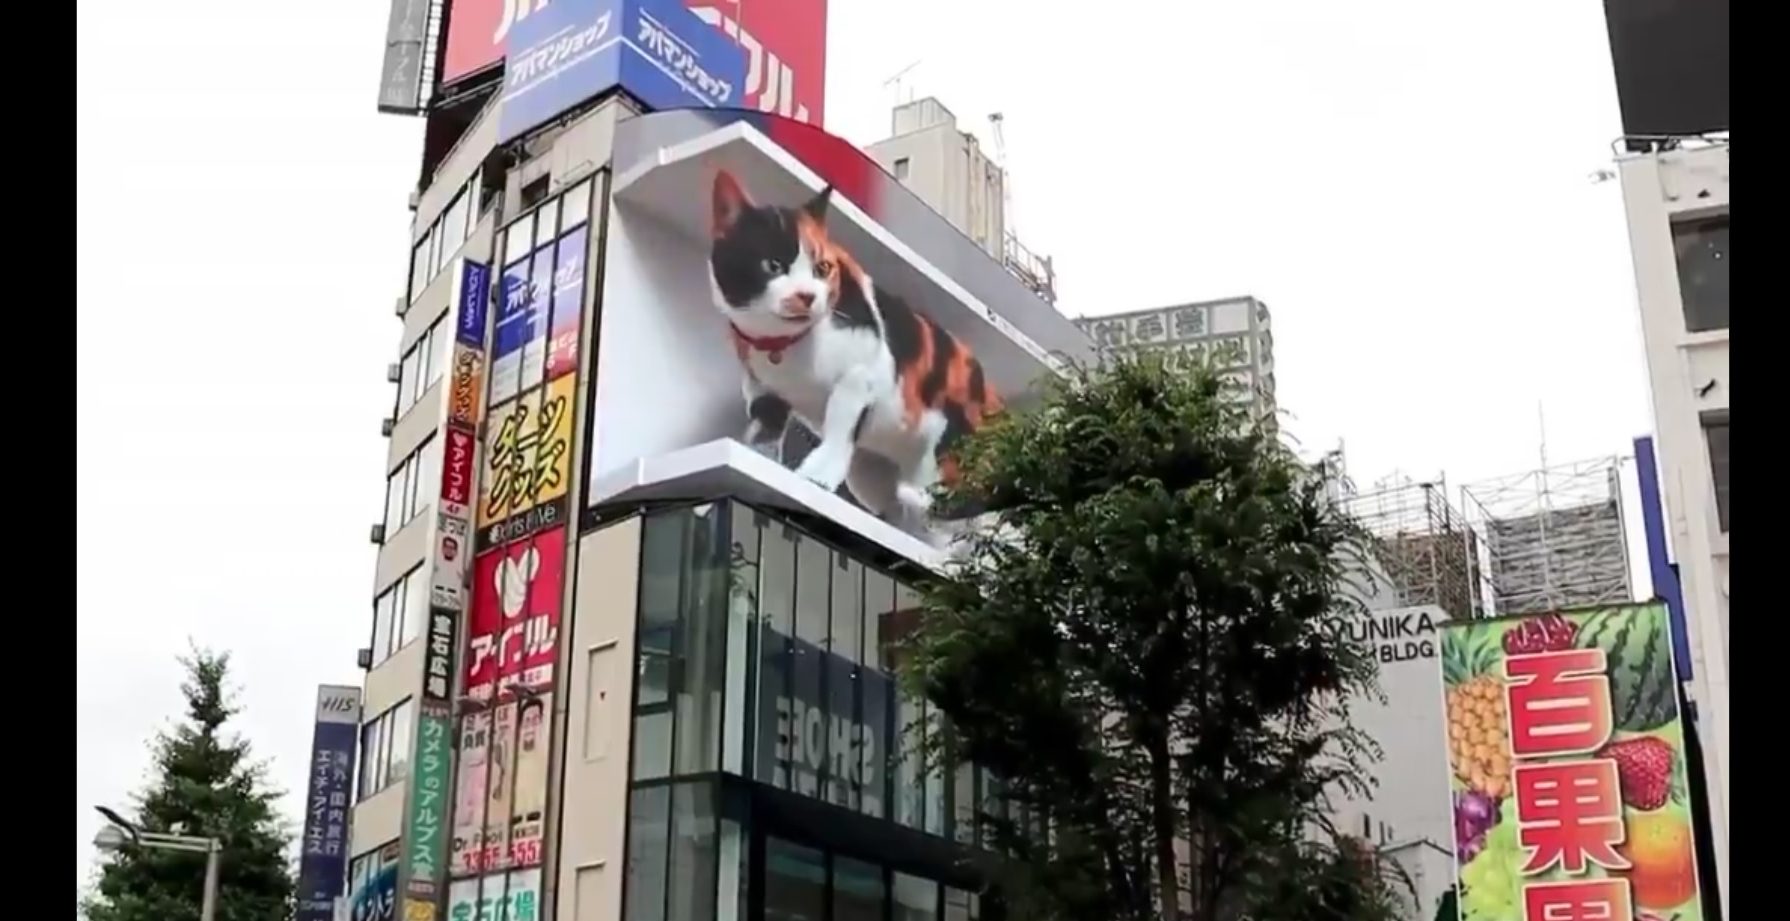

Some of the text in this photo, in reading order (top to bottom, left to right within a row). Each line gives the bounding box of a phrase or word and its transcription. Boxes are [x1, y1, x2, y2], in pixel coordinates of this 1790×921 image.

[511, 9, 612, 87] アパマンショップ
[637, 17, 733, 102] アパマンショップ
[491, 396, 567, 470] ダーツ
[448, 449, 466, 501] アイフル
[487, 439, 567, 519] グッズ
[410, 719, 444, 879] カメラのアルプス堂
